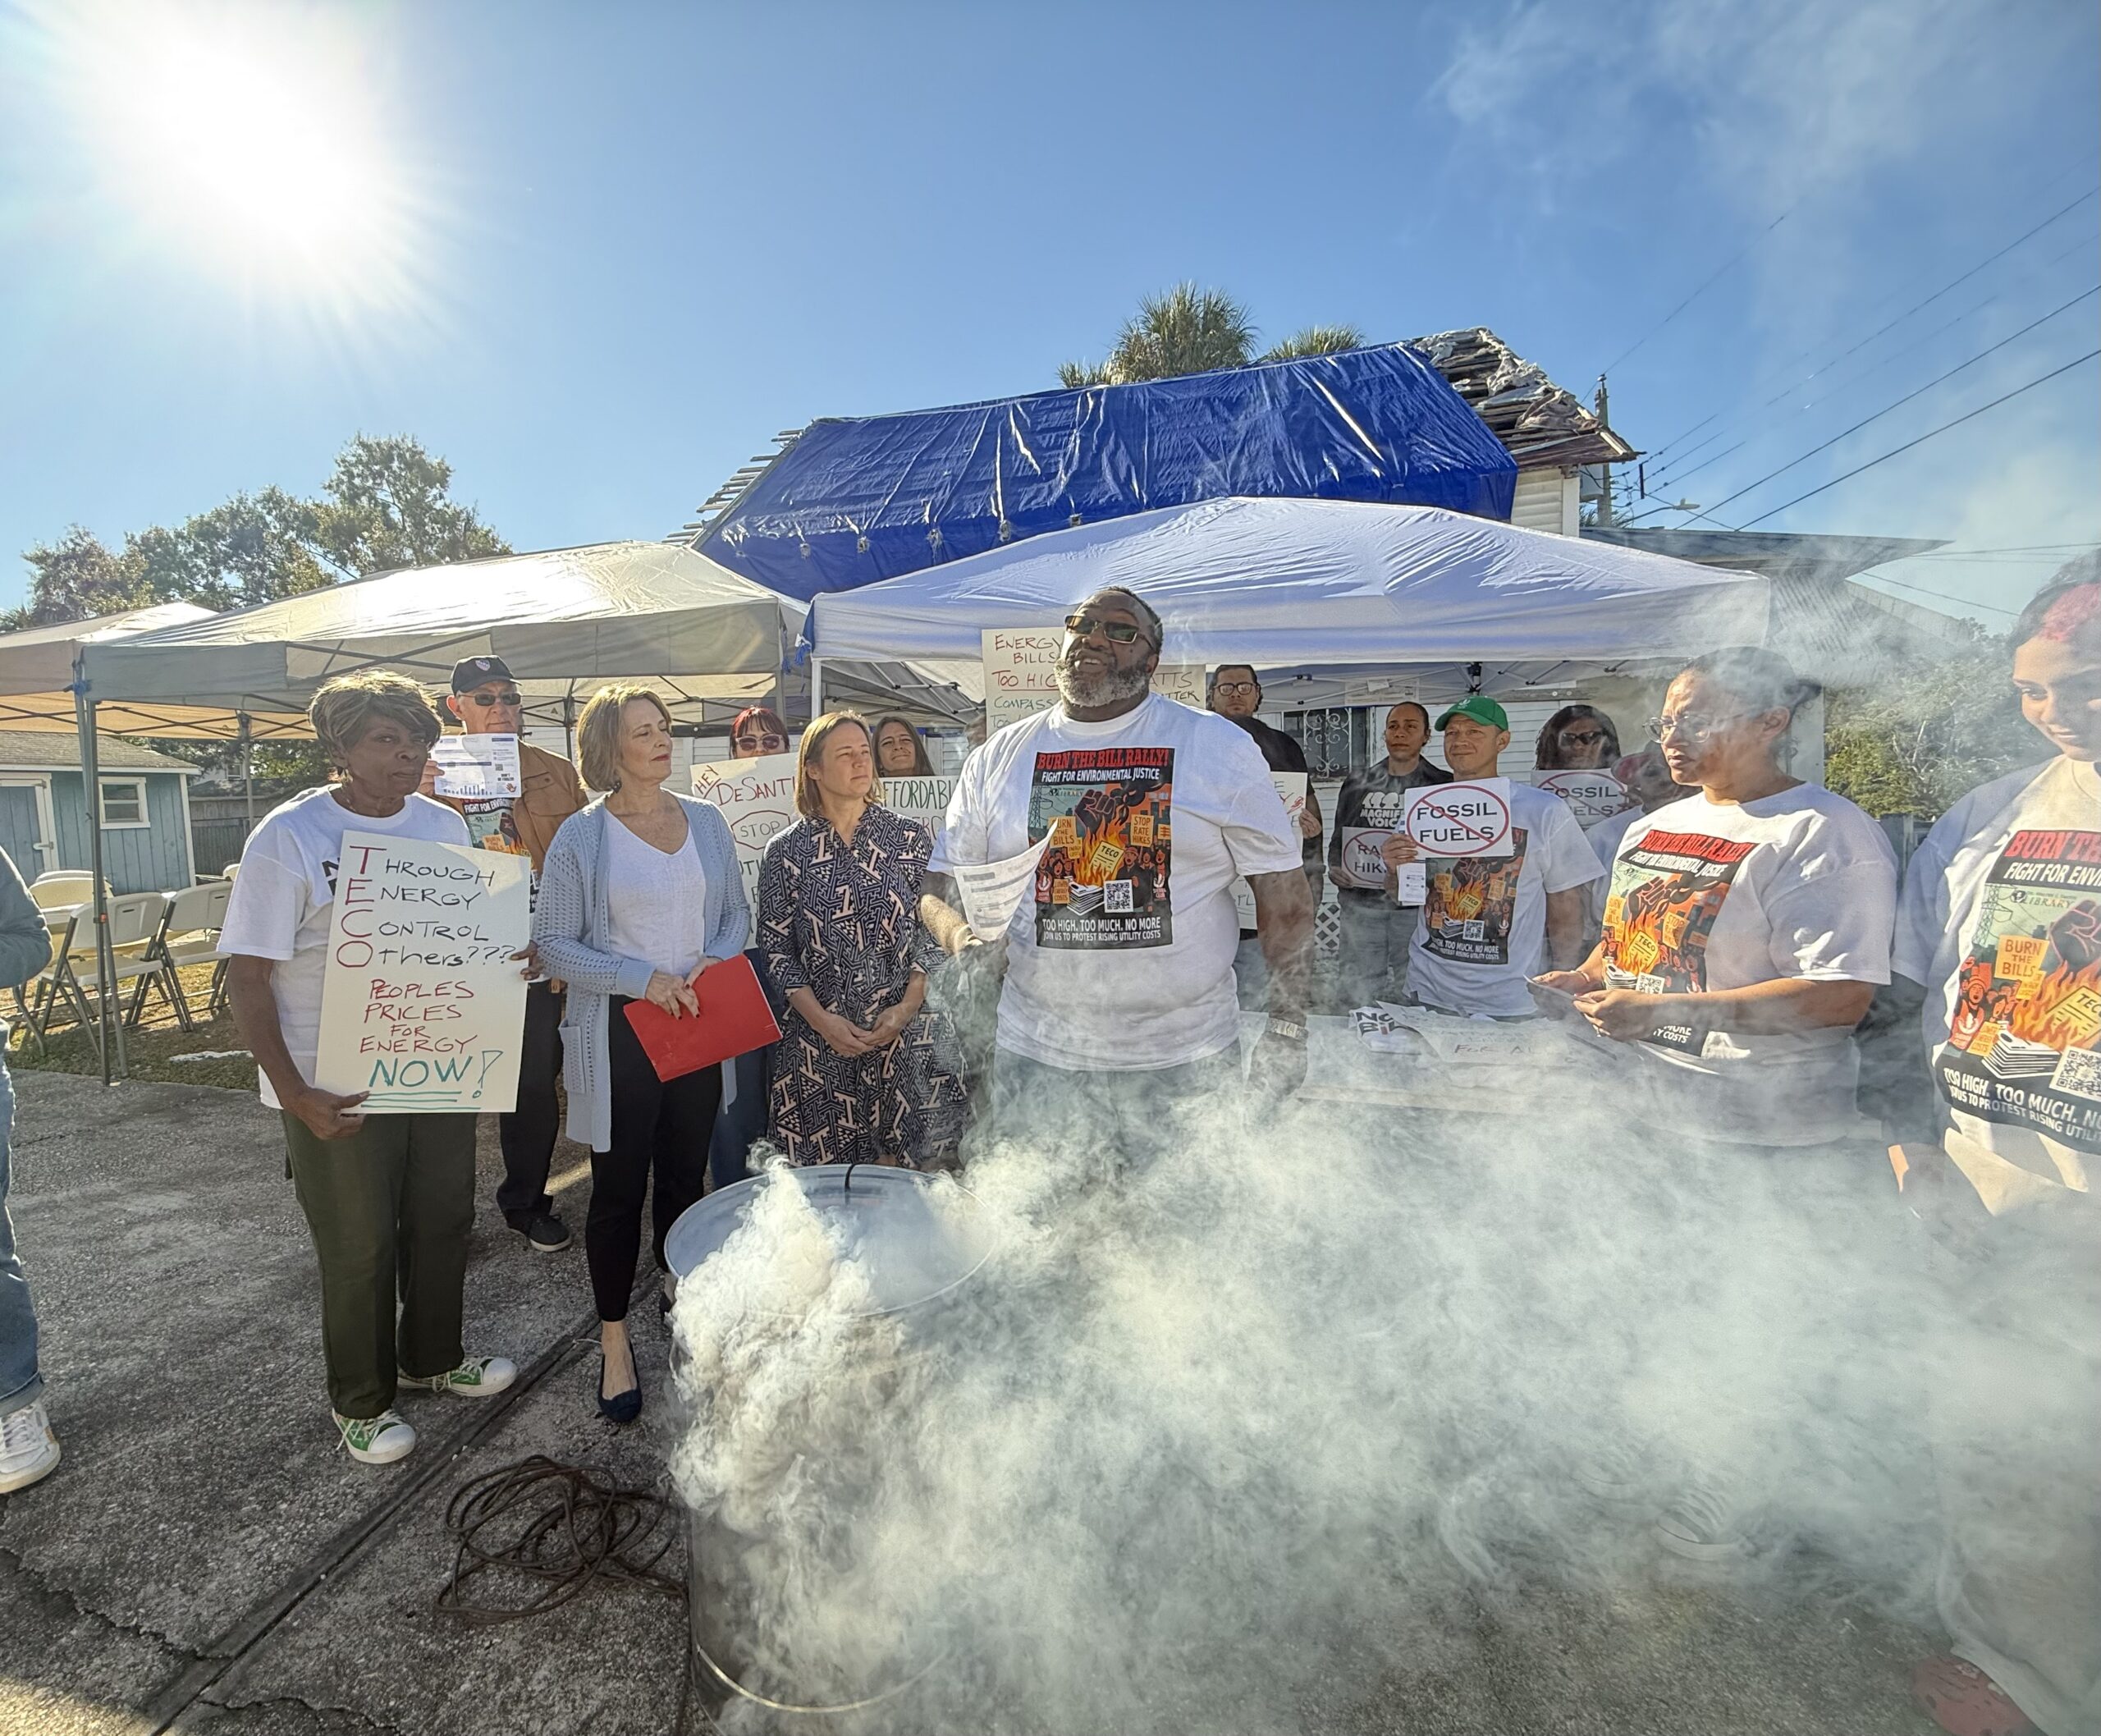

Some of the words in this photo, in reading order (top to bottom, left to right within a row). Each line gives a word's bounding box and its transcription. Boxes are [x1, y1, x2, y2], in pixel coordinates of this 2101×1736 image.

[1037, 751, 1071, 769] BURN
[1071, 750, 1096, 767] THE
[1096, 749, 1124, 767] BILL
[1125, 749, 1169, 767] RALLY!
[694, 765, 719, 795] HEY
[1041, 771, 1061, 782] FIGHT
[1062, 770, 1075, 782] FOR
[1077, 769, 1132, 781] ENVIRONMENTAL
[1132, 768, 1160, 781] JUSTICE
[465, 804, 480, 813] FIGHT
[480, 803, 491, 812] FOR
[1417, 802, 1498, 820] FOSSIL
[740, 820, 780, 838] STOP
[1051, 819, 1072, 828] URN
[1133, 816, 1151, 826] STOP
[1133, 826, 1150, 836] RATE
[1420, 827, 1495, 843] FUELS
[1053, 835, 1074, 845] BILLS
[1133, 835, 1151, 845] HIKES
[2004, 831, 2074, 859] BURN
[1101, 845, 1119, 858] TECO
[350, 845, 496, 886] THROUGH
[2003, 862, 2046, 881] FIGHT
[2039, 863, 2070, 883] FOR
[345, 878, 483, 910] ENERGY
[1465, 895, 1479, 906] TECO
[341, 909, 492, 941] CONTROL
[1042, 918, 1056, 930] TOO
[1058, 918, 1078, 932] HIGH.
[1080, 919, 1096, 932] TOO
[1098, 918, 1124, 932] MUCH.
[1125, 918, 1137, 931] NO
[1138, 916, 1161, 929] MORE
[1043, 931, 1053, 941] JOIN
[1055, 931, 1062, 941] US
[1063, 932, 1071, 941] TO
[1072, 932, 1096, 941] PROTEST
[1098, 932, 1118, 941] RISING
[1119, 931, 1142, 941] UTILITY
[1142, 929, 1161, 939] COSTS
[1638, 935, 1656, 952] TECO
[2005, 939, 2043, 956] BURN
[2012, 955, 2033, 964] THE
[2002, 962, 2036, 978] BILLS
[369, 979, 474, 1000] PEOPLES
[364, 1003, 463, 1024] PRICES
[390, 1024, 432, 1039] FOR
[1663, 1030, 1689, 1043] COSTS
[359, 1035, 478, 1054] ENERGY
[1962, 1073, 1989, 1097] HIGH.
[1995, 1083, 2025, 1106] TOO
[2028, 1093, 2077, 1123] MUCH.
[1968, 1092, 1979, 1106] TO
[1979, 1097, 2027, 1118] PROTEST
[2030, 1111, 2063, 1133] RISING
